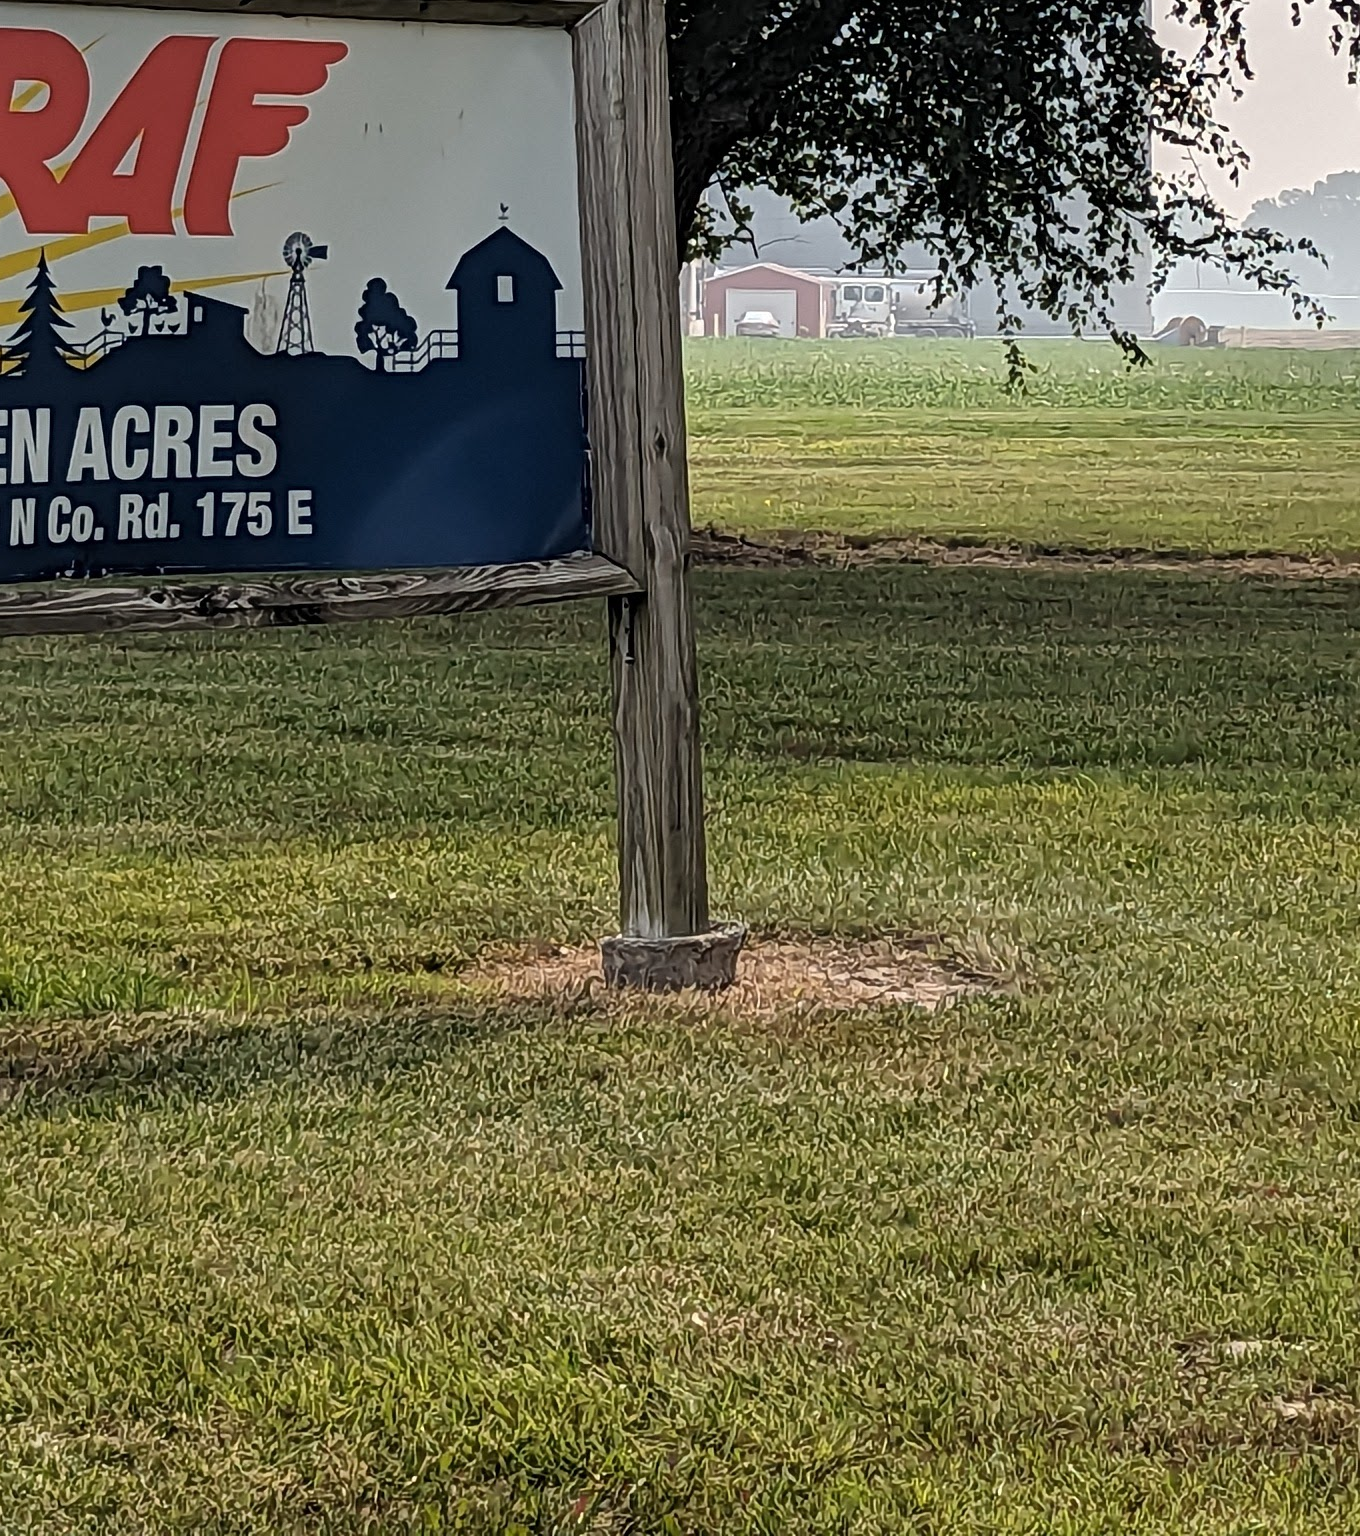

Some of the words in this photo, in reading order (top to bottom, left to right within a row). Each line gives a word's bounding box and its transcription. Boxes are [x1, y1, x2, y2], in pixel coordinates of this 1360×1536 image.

[66, 403, 278, 482] ACRES
[9, 497, 36, 546] N
[47, 495, 104, 544] Co.
[117, 492, 181, 540] Rd.
[196, 491, 273, 537] 175
[288, 489, 313, 535] E
